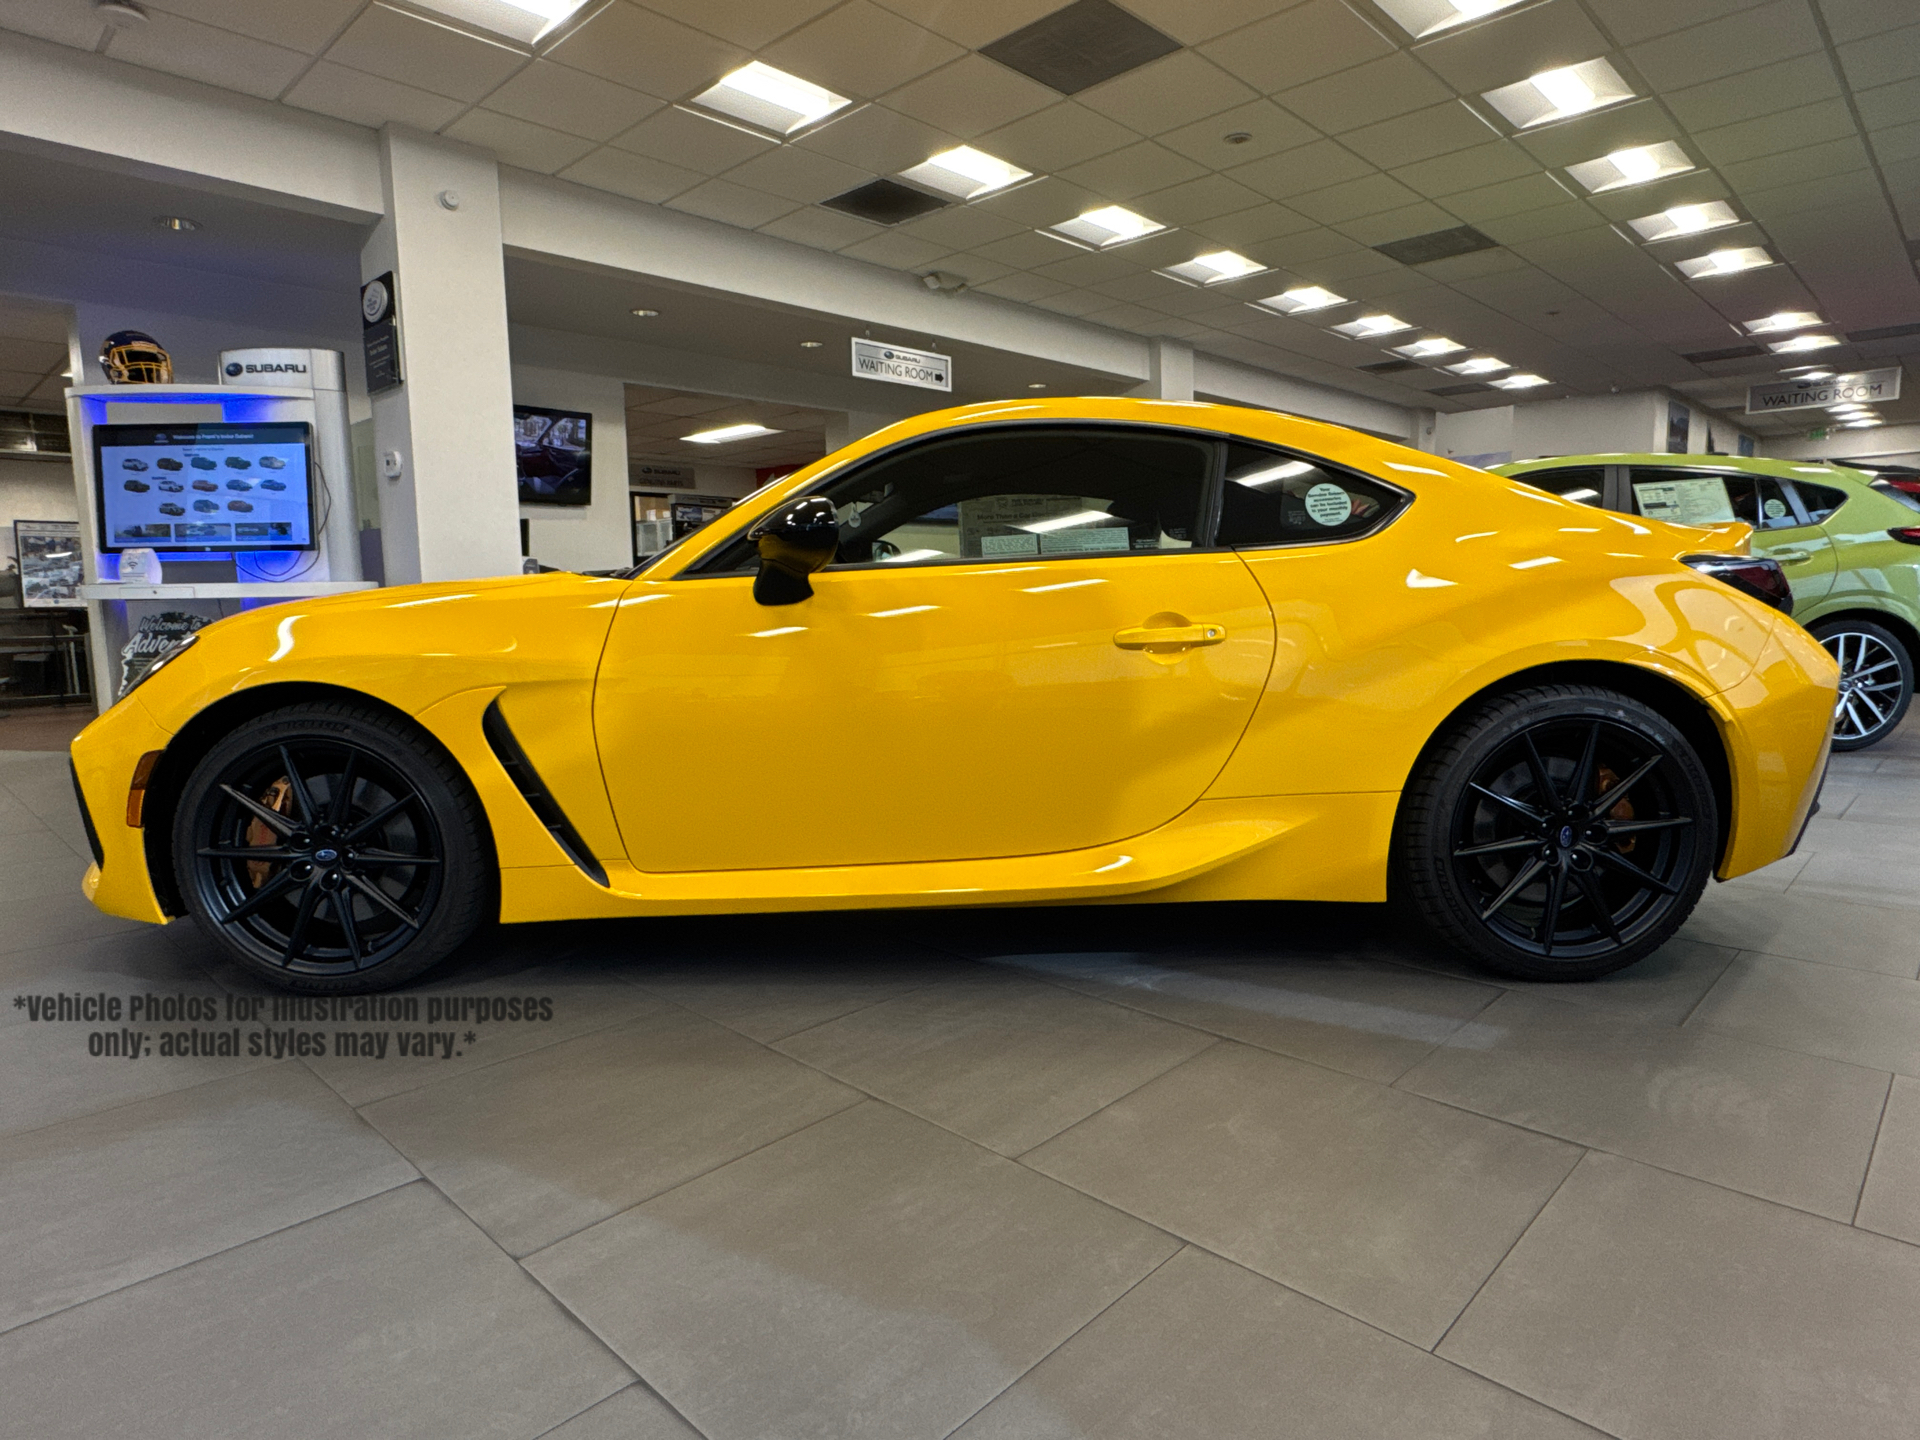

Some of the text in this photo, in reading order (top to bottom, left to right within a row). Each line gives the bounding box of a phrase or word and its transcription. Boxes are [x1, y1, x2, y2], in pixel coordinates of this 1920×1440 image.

[895, 355, 921, 364] SUBARU
[245, 363, 307, 374] SUBARU
[858, 358, 934, 382] WAITING ROOM
[1762, 390, 1828, 407] WAITING
[1833, 383, 1883, 400] ROOM
[140, 617, 202, 631] Welcome to
